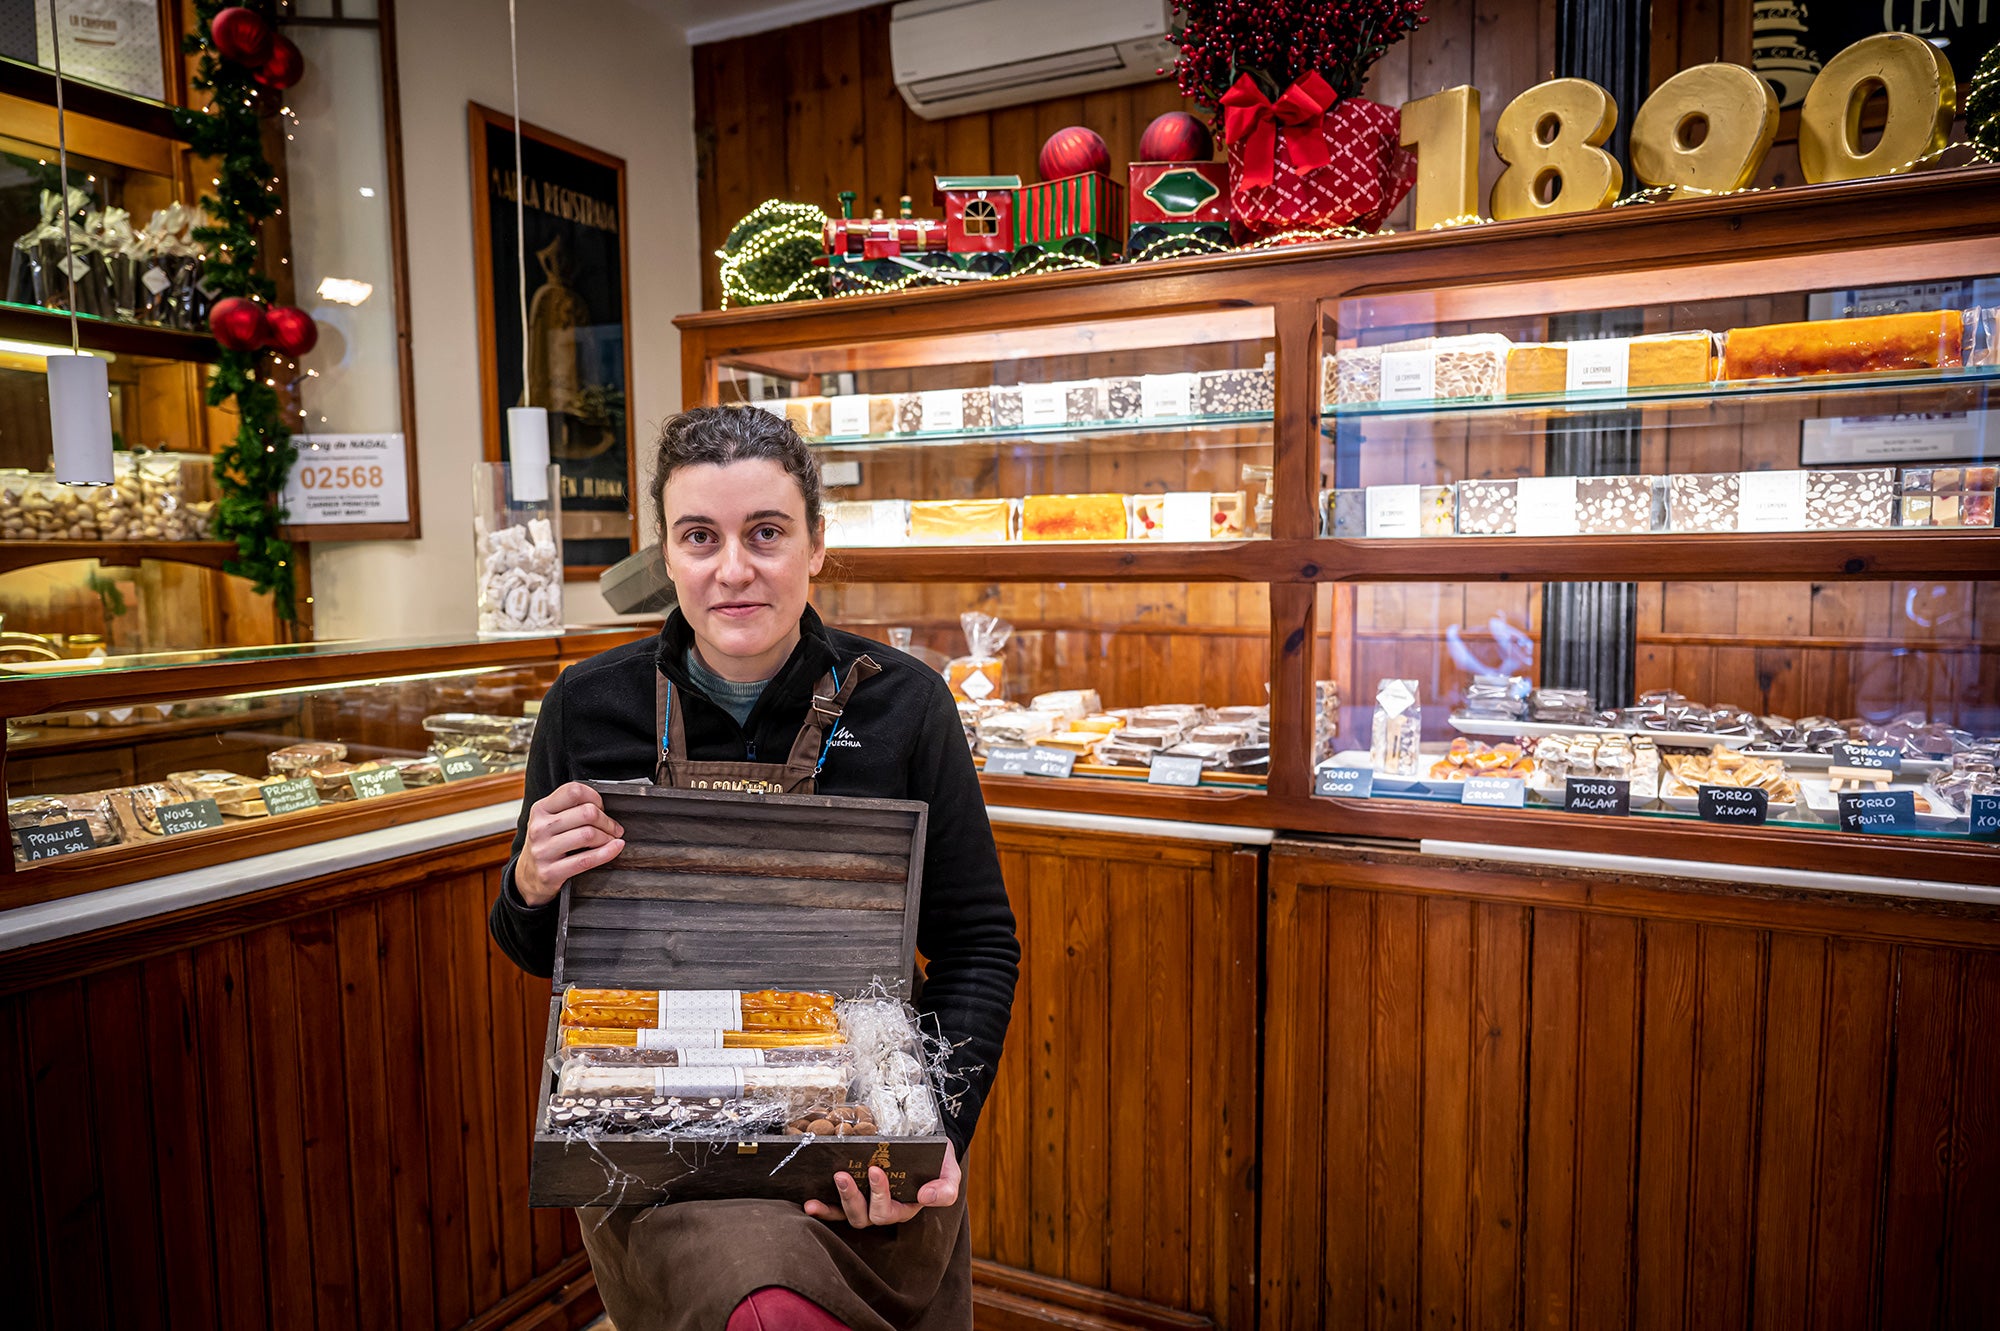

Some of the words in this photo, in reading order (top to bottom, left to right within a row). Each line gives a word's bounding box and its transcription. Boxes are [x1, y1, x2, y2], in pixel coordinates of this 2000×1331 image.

[1399, 31, 1957, 231] 1890
[293, 441, 330, 452] Sorig
[300, 466, 384, 489] 02568
[826, 740, 861, 748] QUECHUA
[1323, 770, 1359, 779] TORRO
[1323, 782, 1354, 792] COCO
[1470, 780, 1510, 789] TORRO
[1572, 784, 1616, 795] TORRO
[1707, 790, 1752, 801] TORRO
[1846, 797, 1896, 808] TORRO
[164, 808, 194, 821] NOUS
[167, 820, 208, 834] FESTUC
[33, 851, 41, 860] A
[47, 848, 59, 857] LA
[65, 843, 89, 853] SAL
[849, 1160, 862, 1168] La
